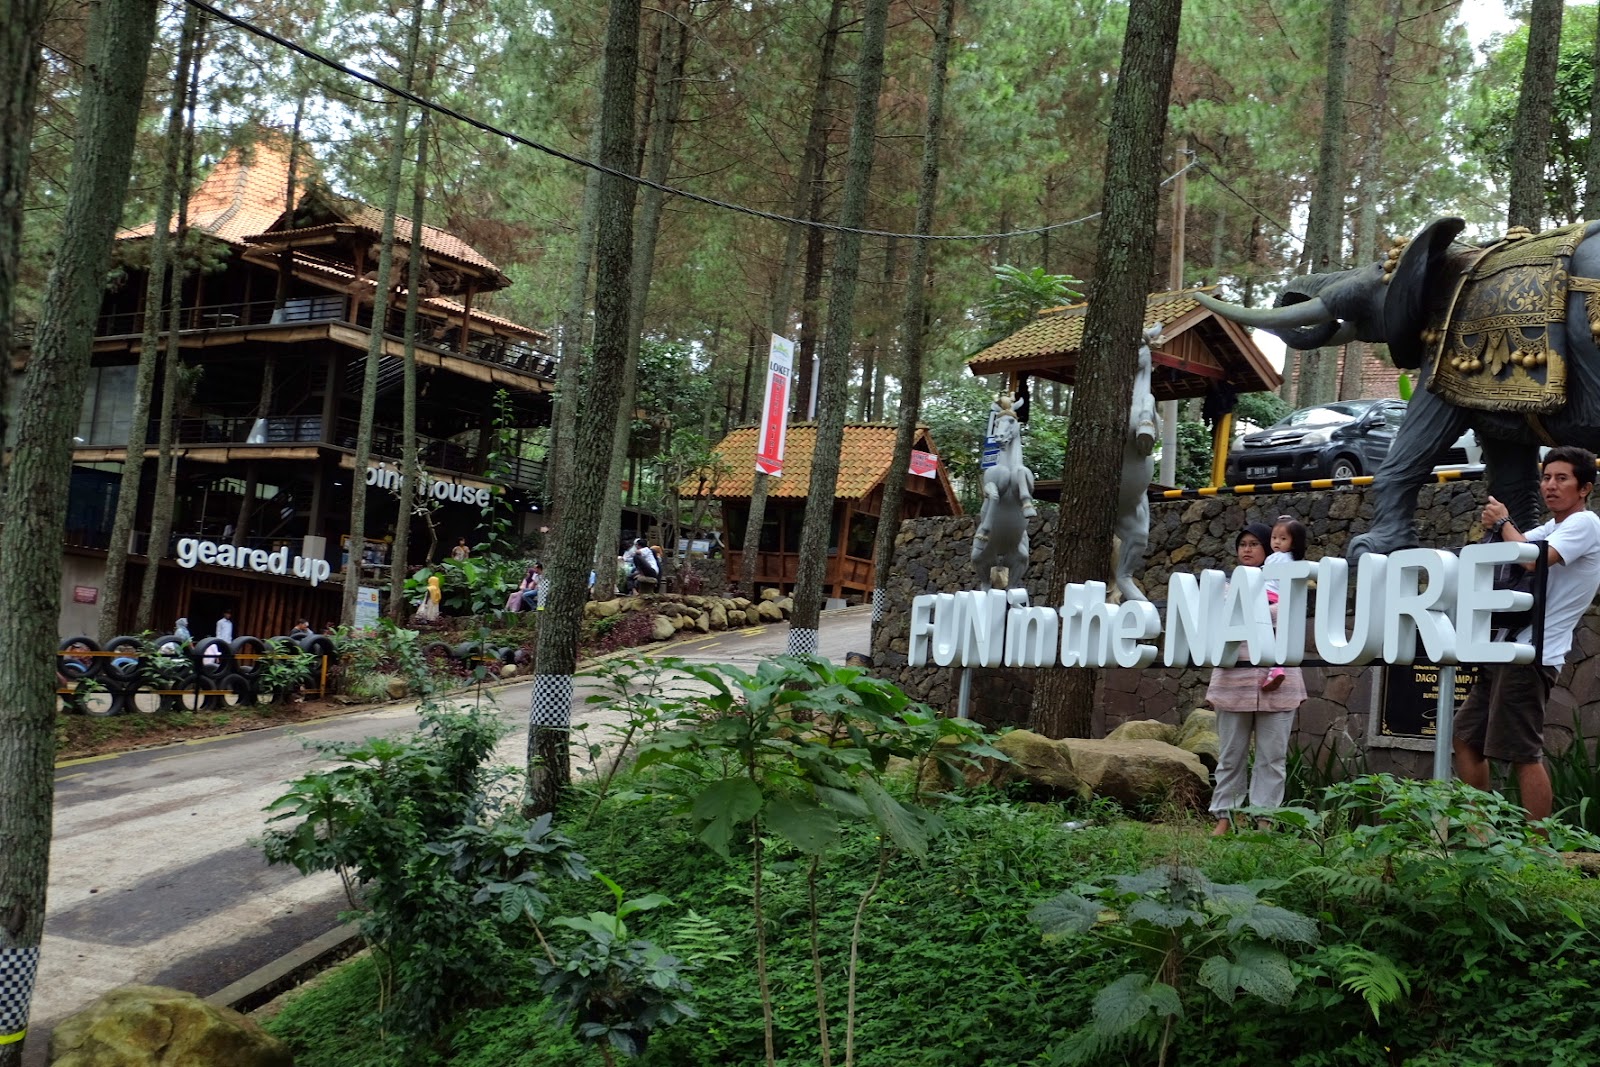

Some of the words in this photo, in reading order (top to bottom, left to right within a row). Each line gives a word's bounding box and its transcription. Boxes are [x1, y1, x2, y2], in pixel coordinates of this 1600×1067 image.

[769, 360, 790, 377] LOKET
[366, 461, 404, 489] pin
[176, 537, 289, 575] geared
[293, 555, 331, 587] up
[908, 588, 1007, 668] FUN
[1004, 587, 1059, 668] in
[1059, 580, 1161, 668] the
[1163, 541, 1540, 668] NATURE
[1415, 673, 1438, 683] DAGO
